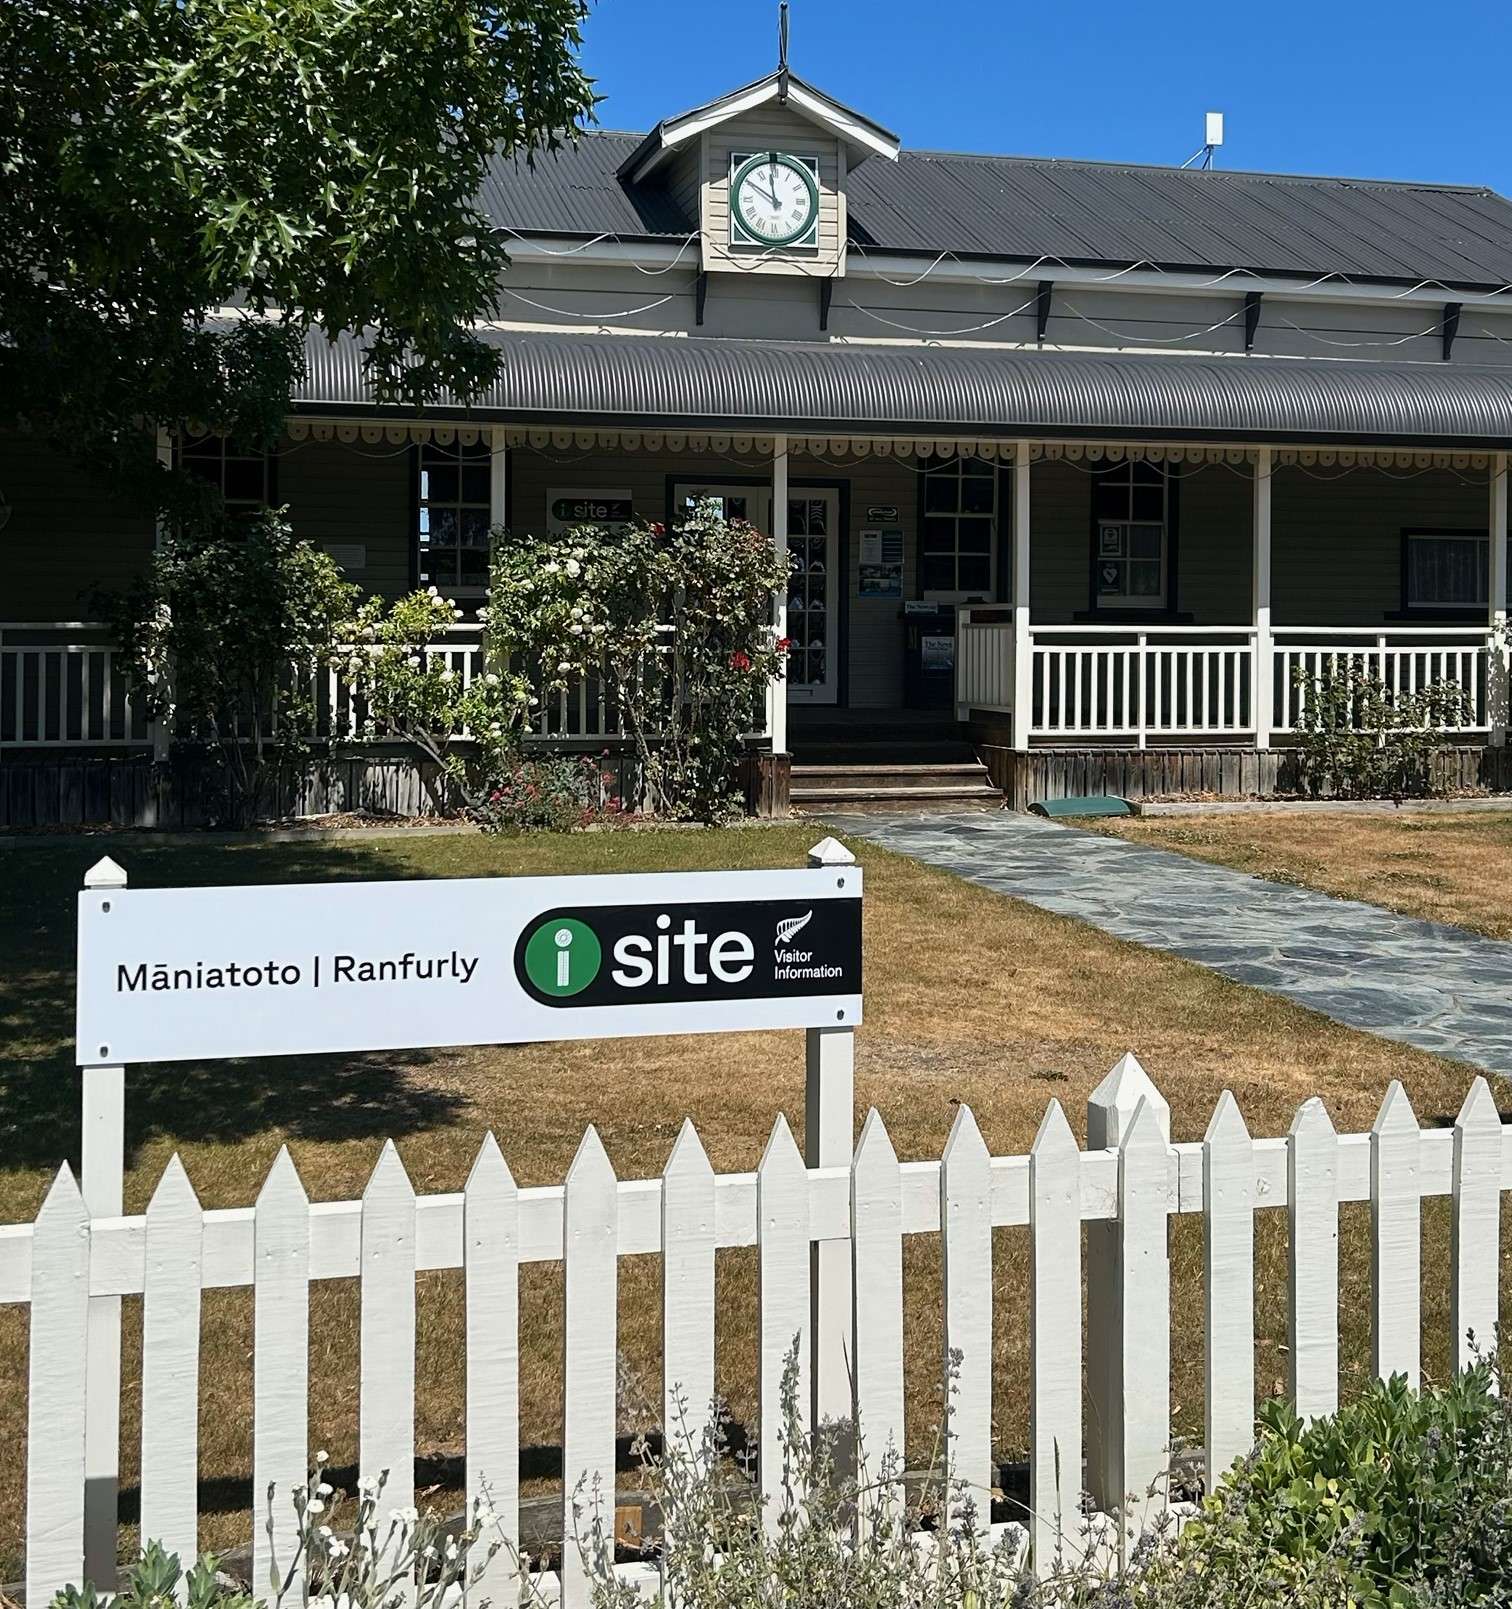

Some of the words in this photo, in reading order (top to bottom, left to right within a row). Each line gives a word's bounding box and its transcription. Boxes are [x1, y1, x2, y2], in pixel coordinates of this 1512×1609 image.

[574, 501, 608, 518] site
[611, 914, 755, 988] site
[774, 949, 813, 963] Visitor
[117, 961, 301, 992] Māniatoto
[334, 951, 479, 983] Ranfurly
[774, 964, 843, 980] Information
